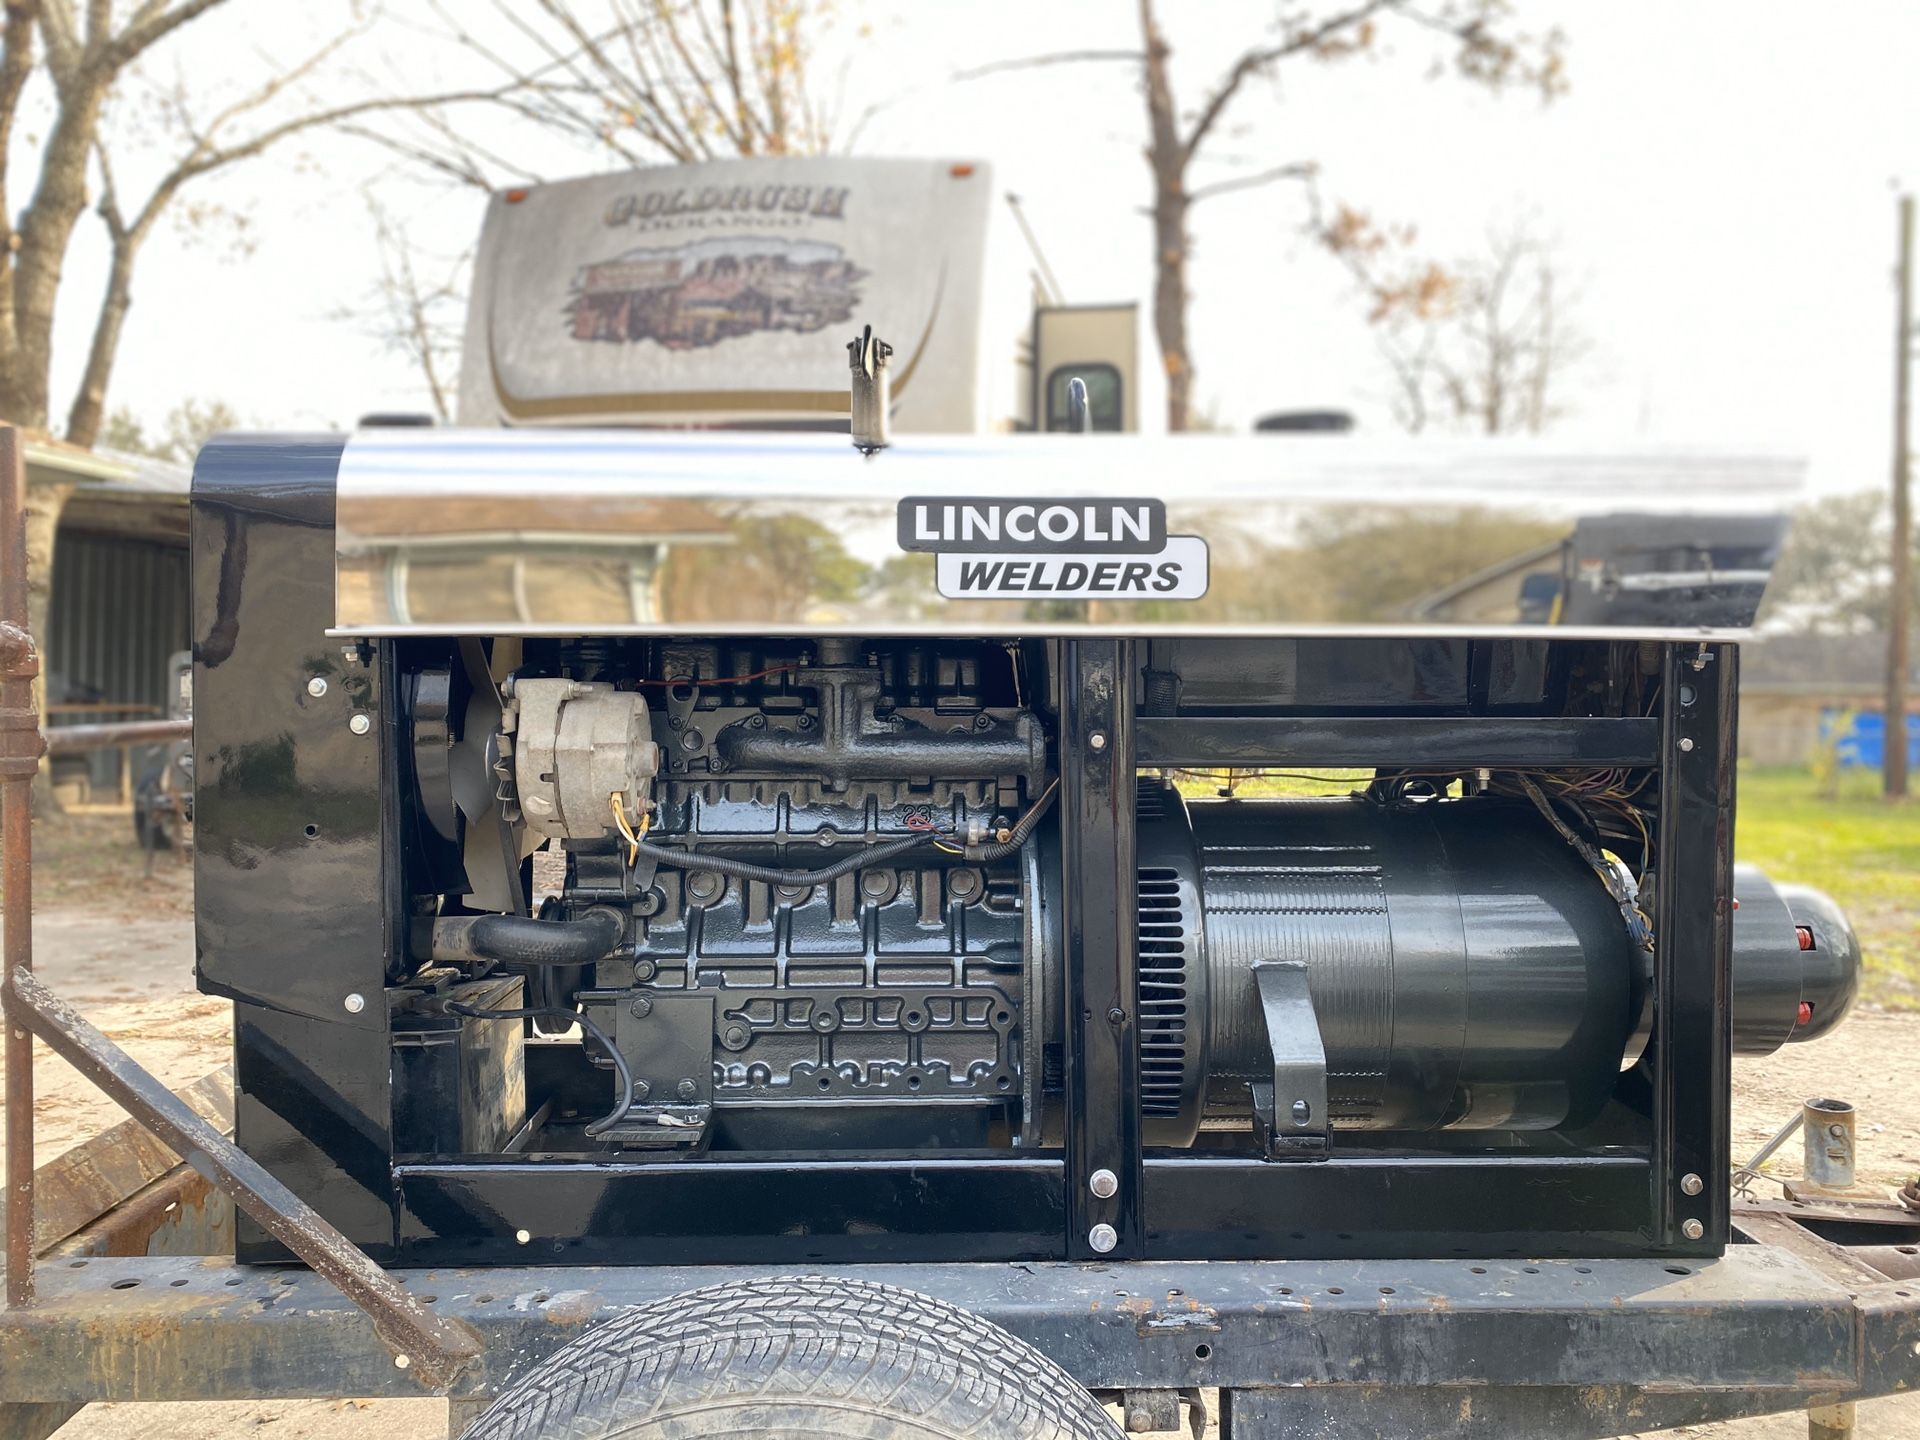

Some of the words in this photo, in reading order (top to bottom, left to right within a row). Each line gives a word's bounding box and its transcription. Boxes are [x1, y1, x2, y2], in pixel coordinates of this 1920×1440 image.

[915, 505, 1150, 542] LINCOLN
[959, 561, 1182, 592] WELDERS
[903, 804, 931, 825] 23
